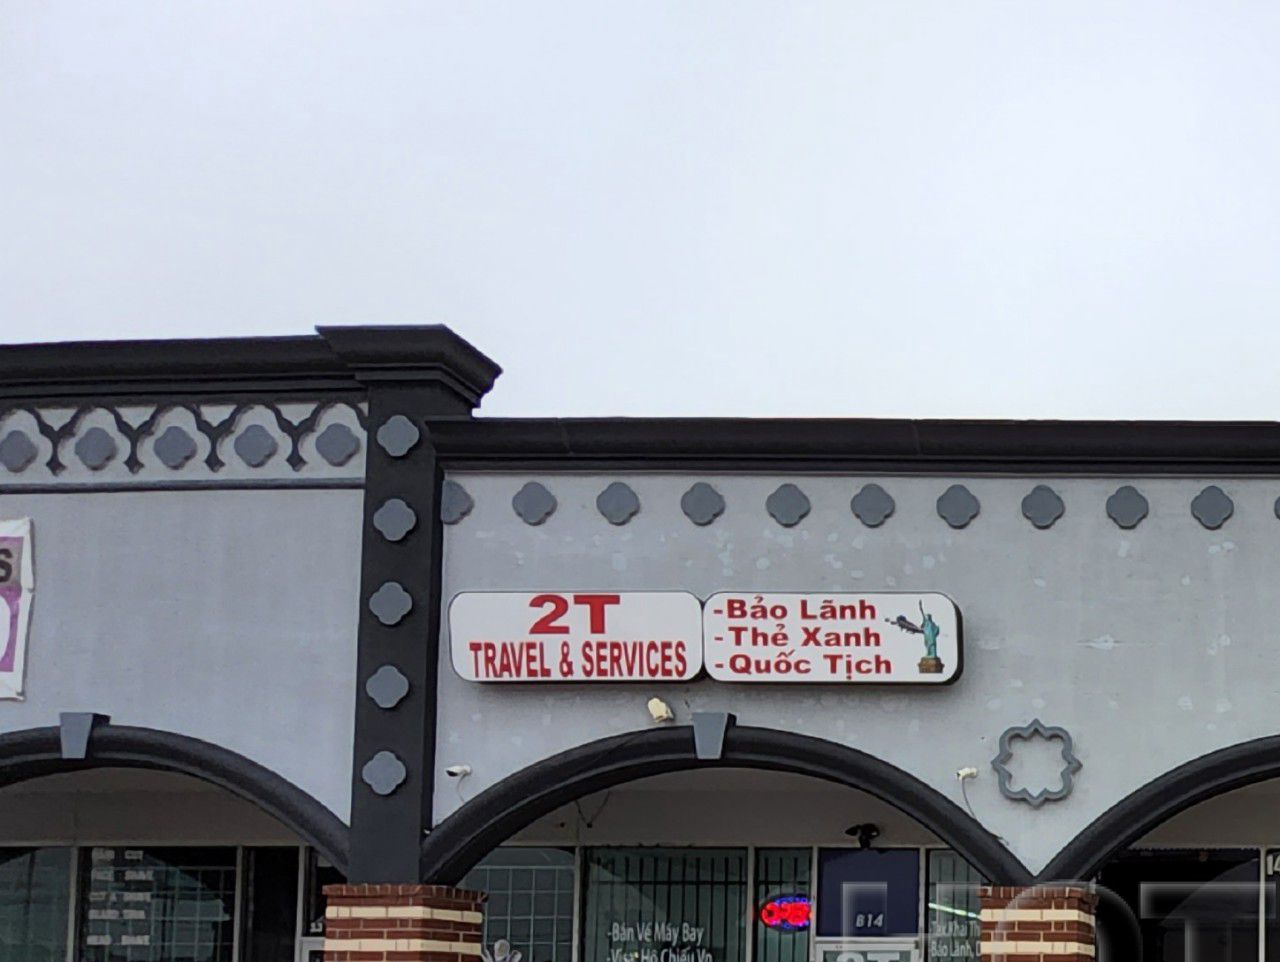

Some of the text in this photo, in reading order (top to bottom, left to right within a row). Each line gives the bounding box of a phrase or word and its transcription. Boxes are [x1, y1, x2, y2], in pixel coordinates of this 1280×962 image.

[529, 594, 620, 634] 2T
[800, 599, 876, 620] Lãnh
[801, 626, 880, 647] Xanh
[469, 640, 686, 678] TRAVEL & SERVICES
[823, 655, 891, 680] Tịch
[856, 913, 884, 928] B14
[682, 922, 705, 947] Bay
